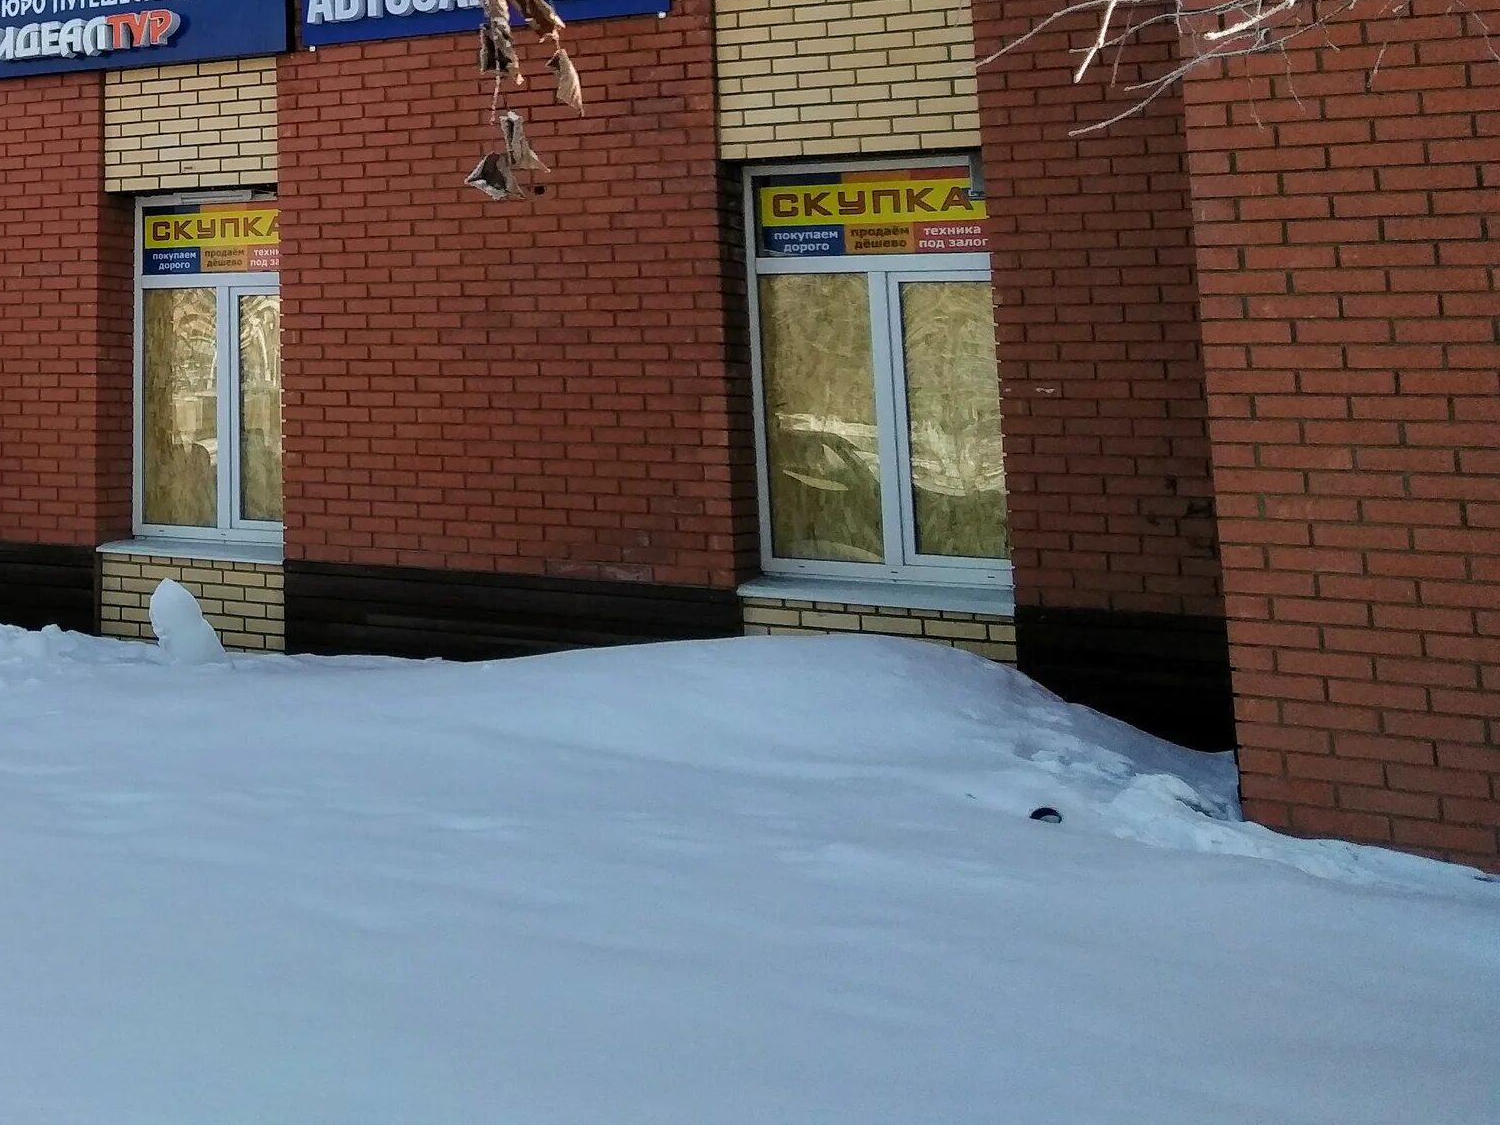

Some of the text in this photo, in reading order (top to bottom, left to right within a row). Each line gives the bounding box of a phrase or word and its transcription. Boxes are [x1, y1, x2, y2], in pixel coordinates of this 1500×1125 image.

[772, 186, 975, 218] СКУПКА
[774, 229, 838, 243] покупаем
[924, 225, 981, 236] техника
[783, 242, 830, 254] дорого
[918, 237, 989, 249] под залог
[152, 250, 197, 261] покупаем
[158, 261, 191, 271] дорого
[250, 259, 268, 267] под
